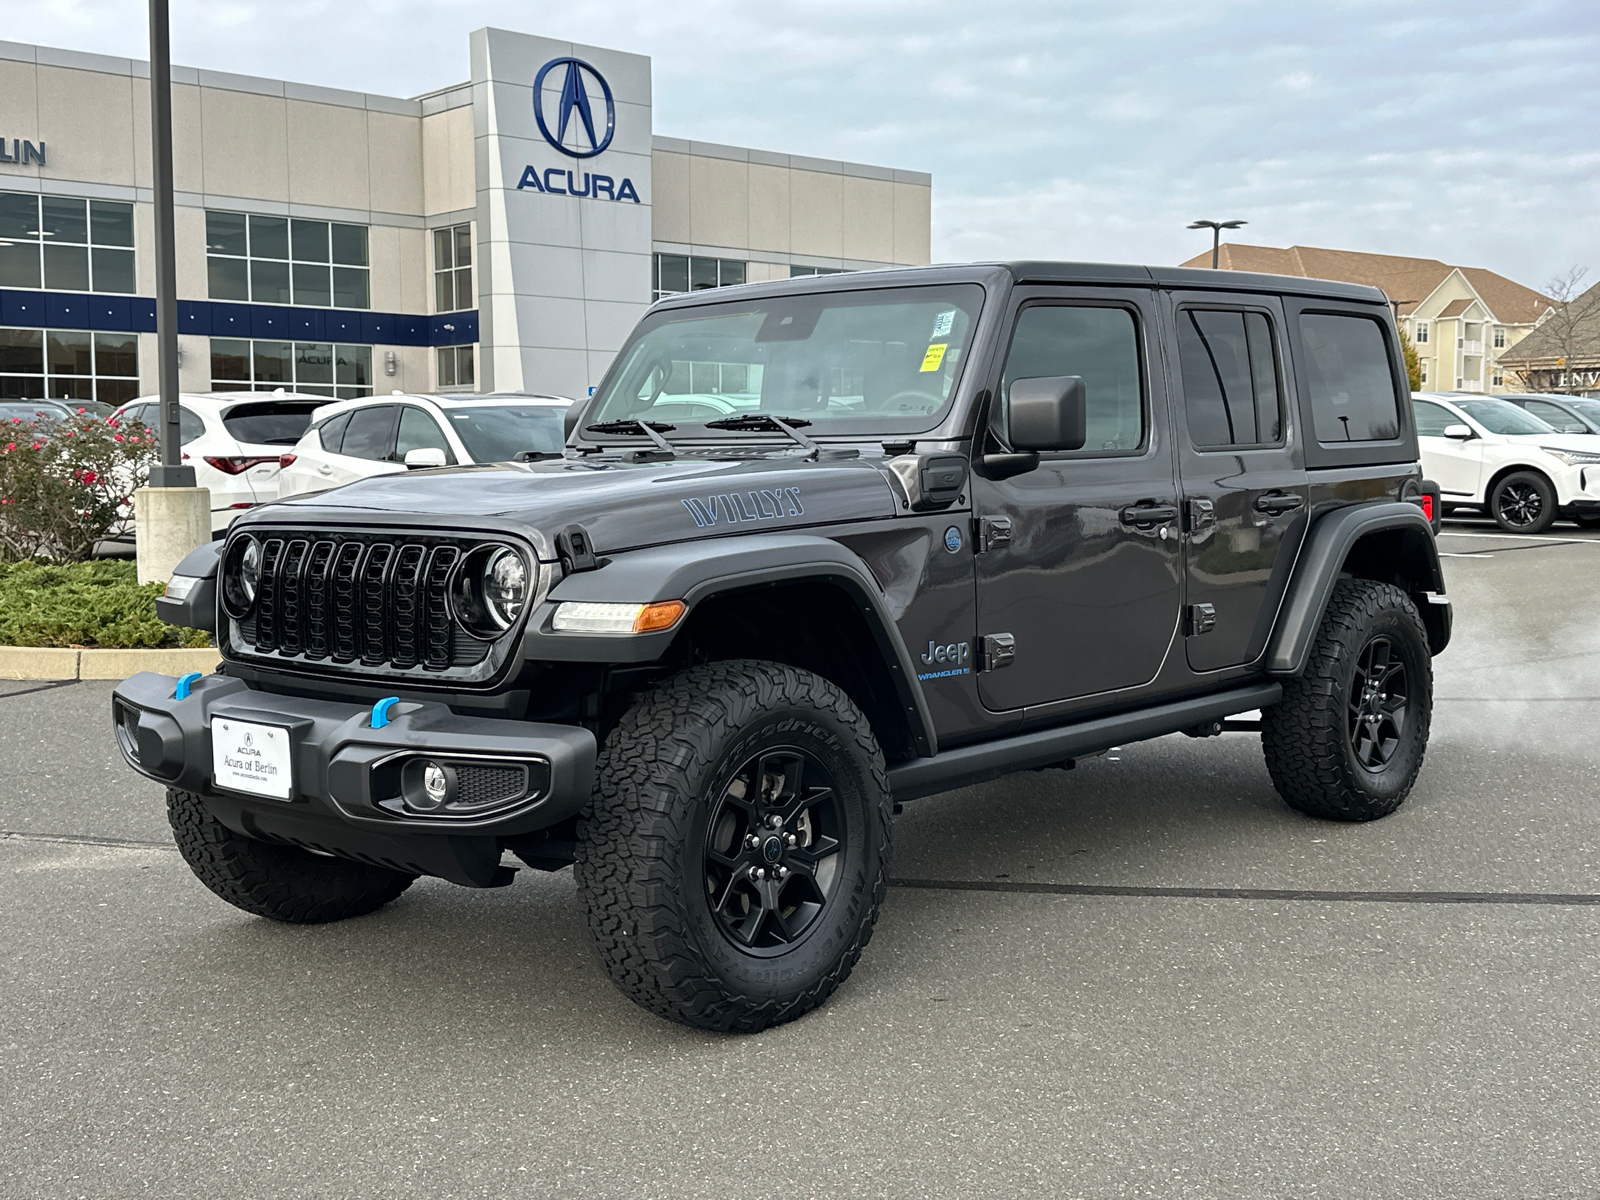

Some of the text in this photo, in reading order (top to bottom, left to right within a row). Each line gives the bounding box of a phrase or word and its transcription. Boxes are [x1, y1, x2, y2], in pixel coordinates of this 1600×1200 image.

[0, 137, 46, 166] LIN
[517, 165, 641, 204] ACURA
[681, 487, 804, 527] WILLYS
[921, 640, 970, 665] Jeep
[918, 668, 963, 681] WRANGLER
[237, 747, 261, 757] ACURA
[224, 755, 278, 775] Acura of Berlin
